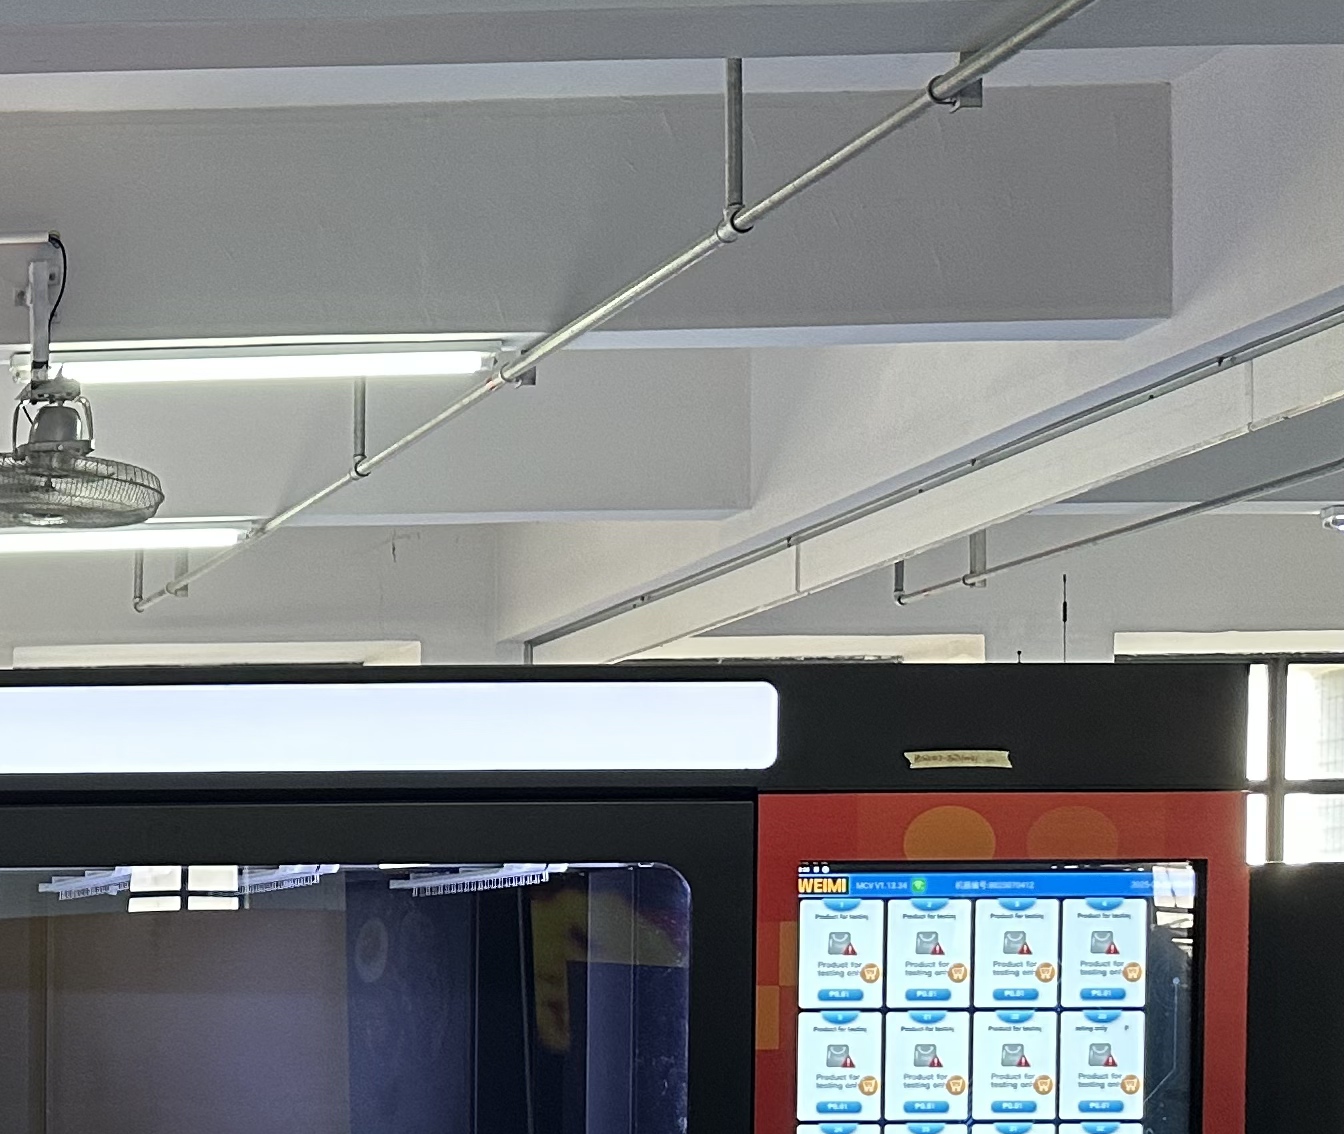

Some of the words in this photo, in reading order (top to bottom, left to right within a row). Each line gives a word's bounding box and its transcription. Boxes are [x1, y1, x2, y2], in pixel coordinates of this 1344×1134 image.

[798, 879, 846, 893] WEIMI
[817, 961, 849, 969] Product
[851, 961, 863, 969] for
[905, 961, 936, 969] Product
[938, 961, 950, 969] for
[992, 961, 1024, 969] Product
[1026, 961, 1038, 969] for
[1079, 961, 1111, 969] Product
[1113, 961, 1125, 969] for
[816, 1073, 847, 1081] Product
[849, 1073, 861, 1081] for
[903, 1073, 935, 1081] Product
[937, 1073, 949, 1081] for
[991, 1073, 1022, 1081] Product
[1024, 1073, 1036, 1081] for
[1078, 1073, 1109, 1081] Product
[1111, 1073, 1123, 1081] for
